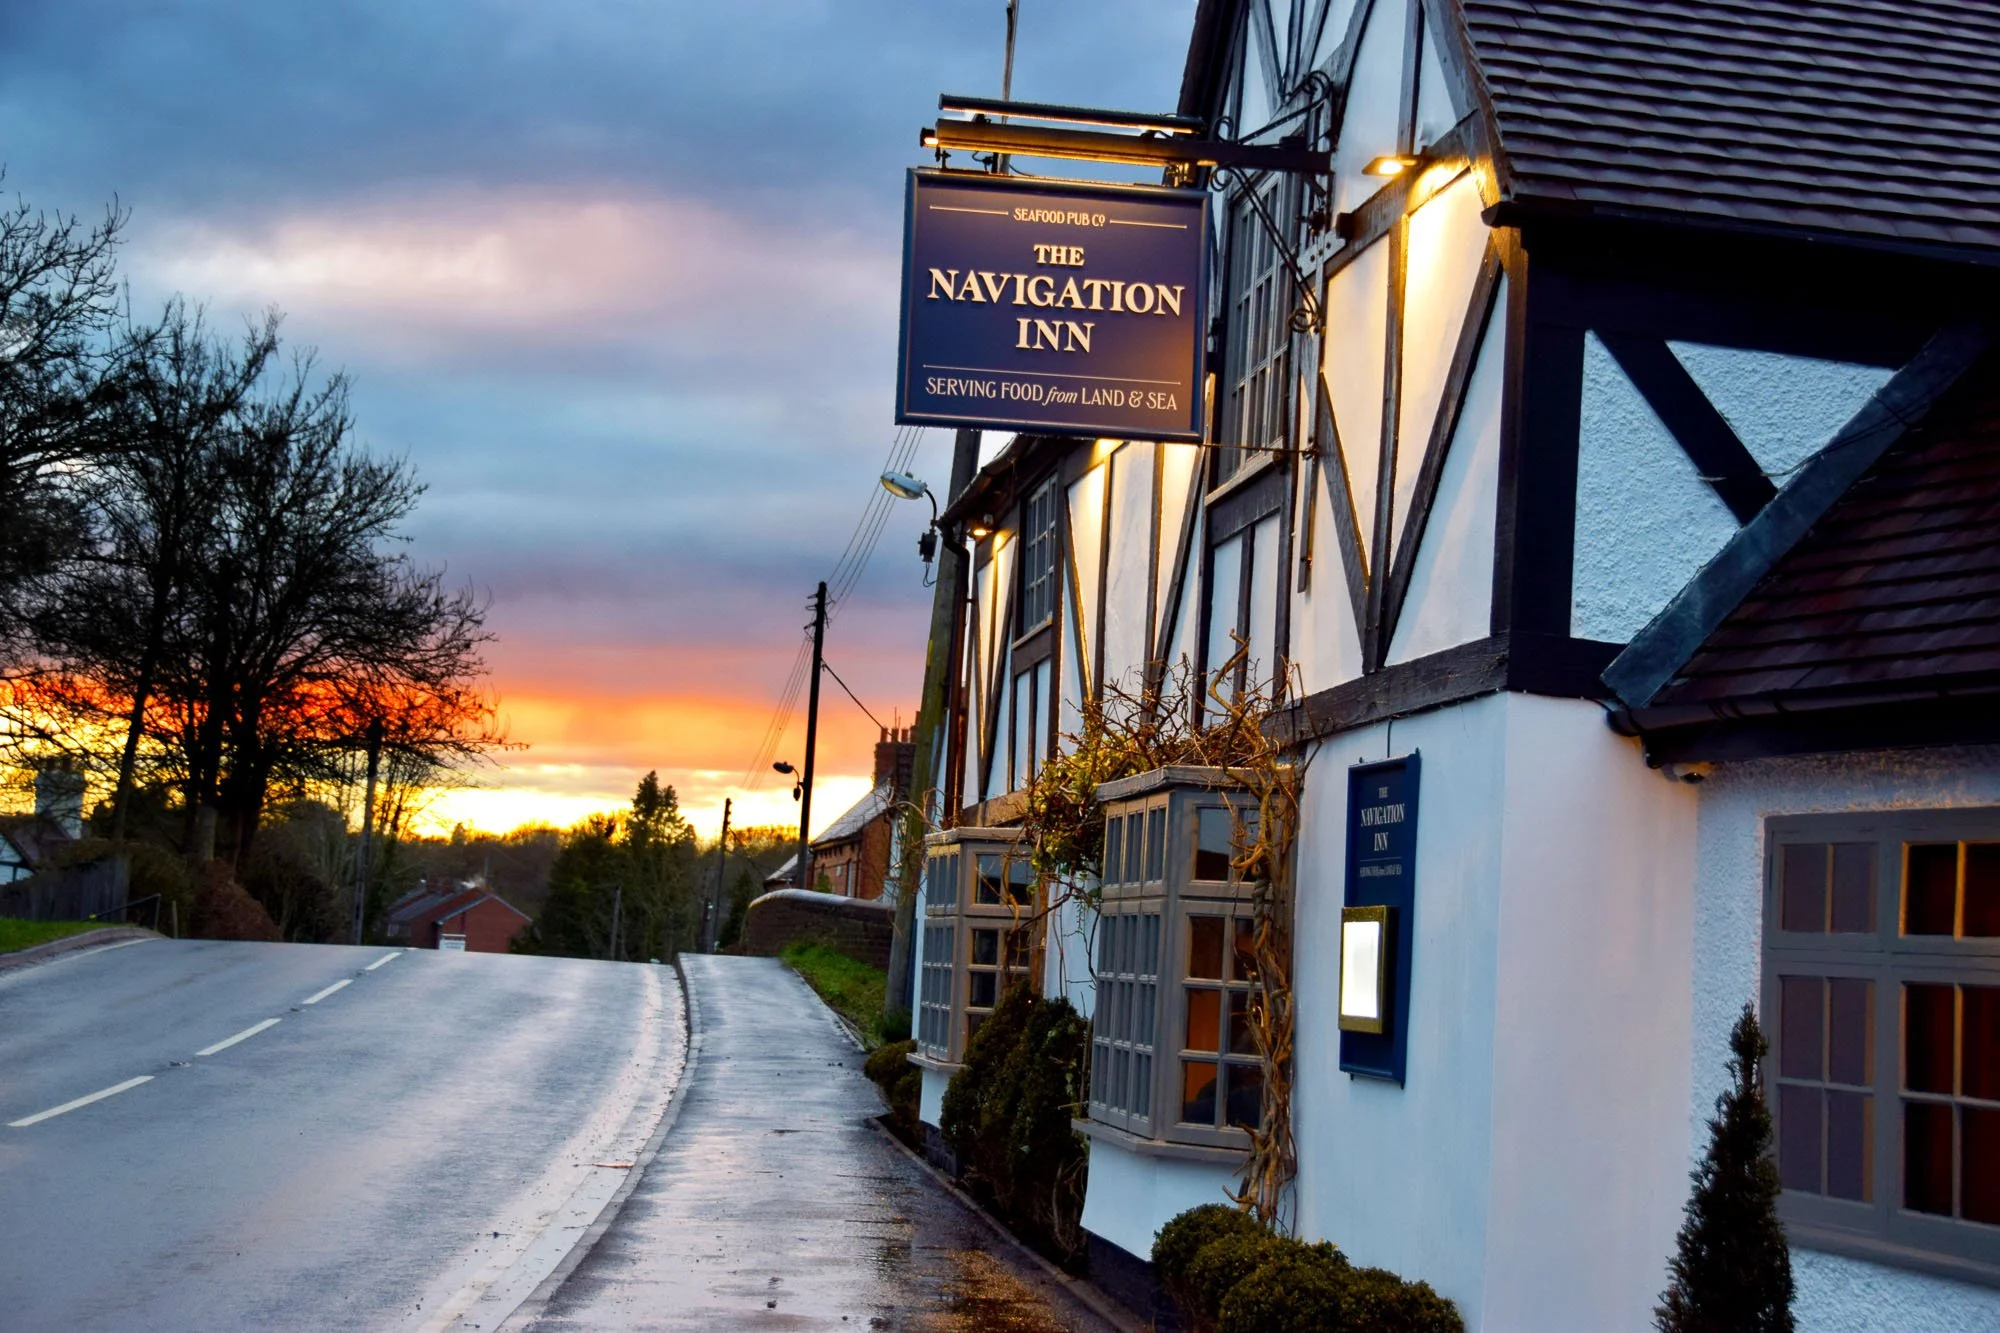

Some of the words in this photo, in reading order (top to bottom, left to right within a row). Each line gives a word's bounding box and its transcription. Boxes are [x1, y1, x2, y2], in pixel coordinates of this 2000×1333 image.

[1013, 207, 1065, 224] SEAFOOD
[1066, 211, 1089, 226] PUB
[1033, 244, 1084, 266] THE
[927, 268, 1185, 316] NAVIGATION
[1016, 318, 1095, 352] INN
[925, 376, 997, 399] SERVING
[1000, 381, 1044, 401] FOOD
[1041, 386, 1078, 406] from
[1081, 387, 1125, 407] LAND
[1128, 390, 1144, 408] &
[1145, 391, 1178, 411] SEA
[1360, 803, 1405, 827] NAVIGATION
[1373, 832, 1388, 852] INN
